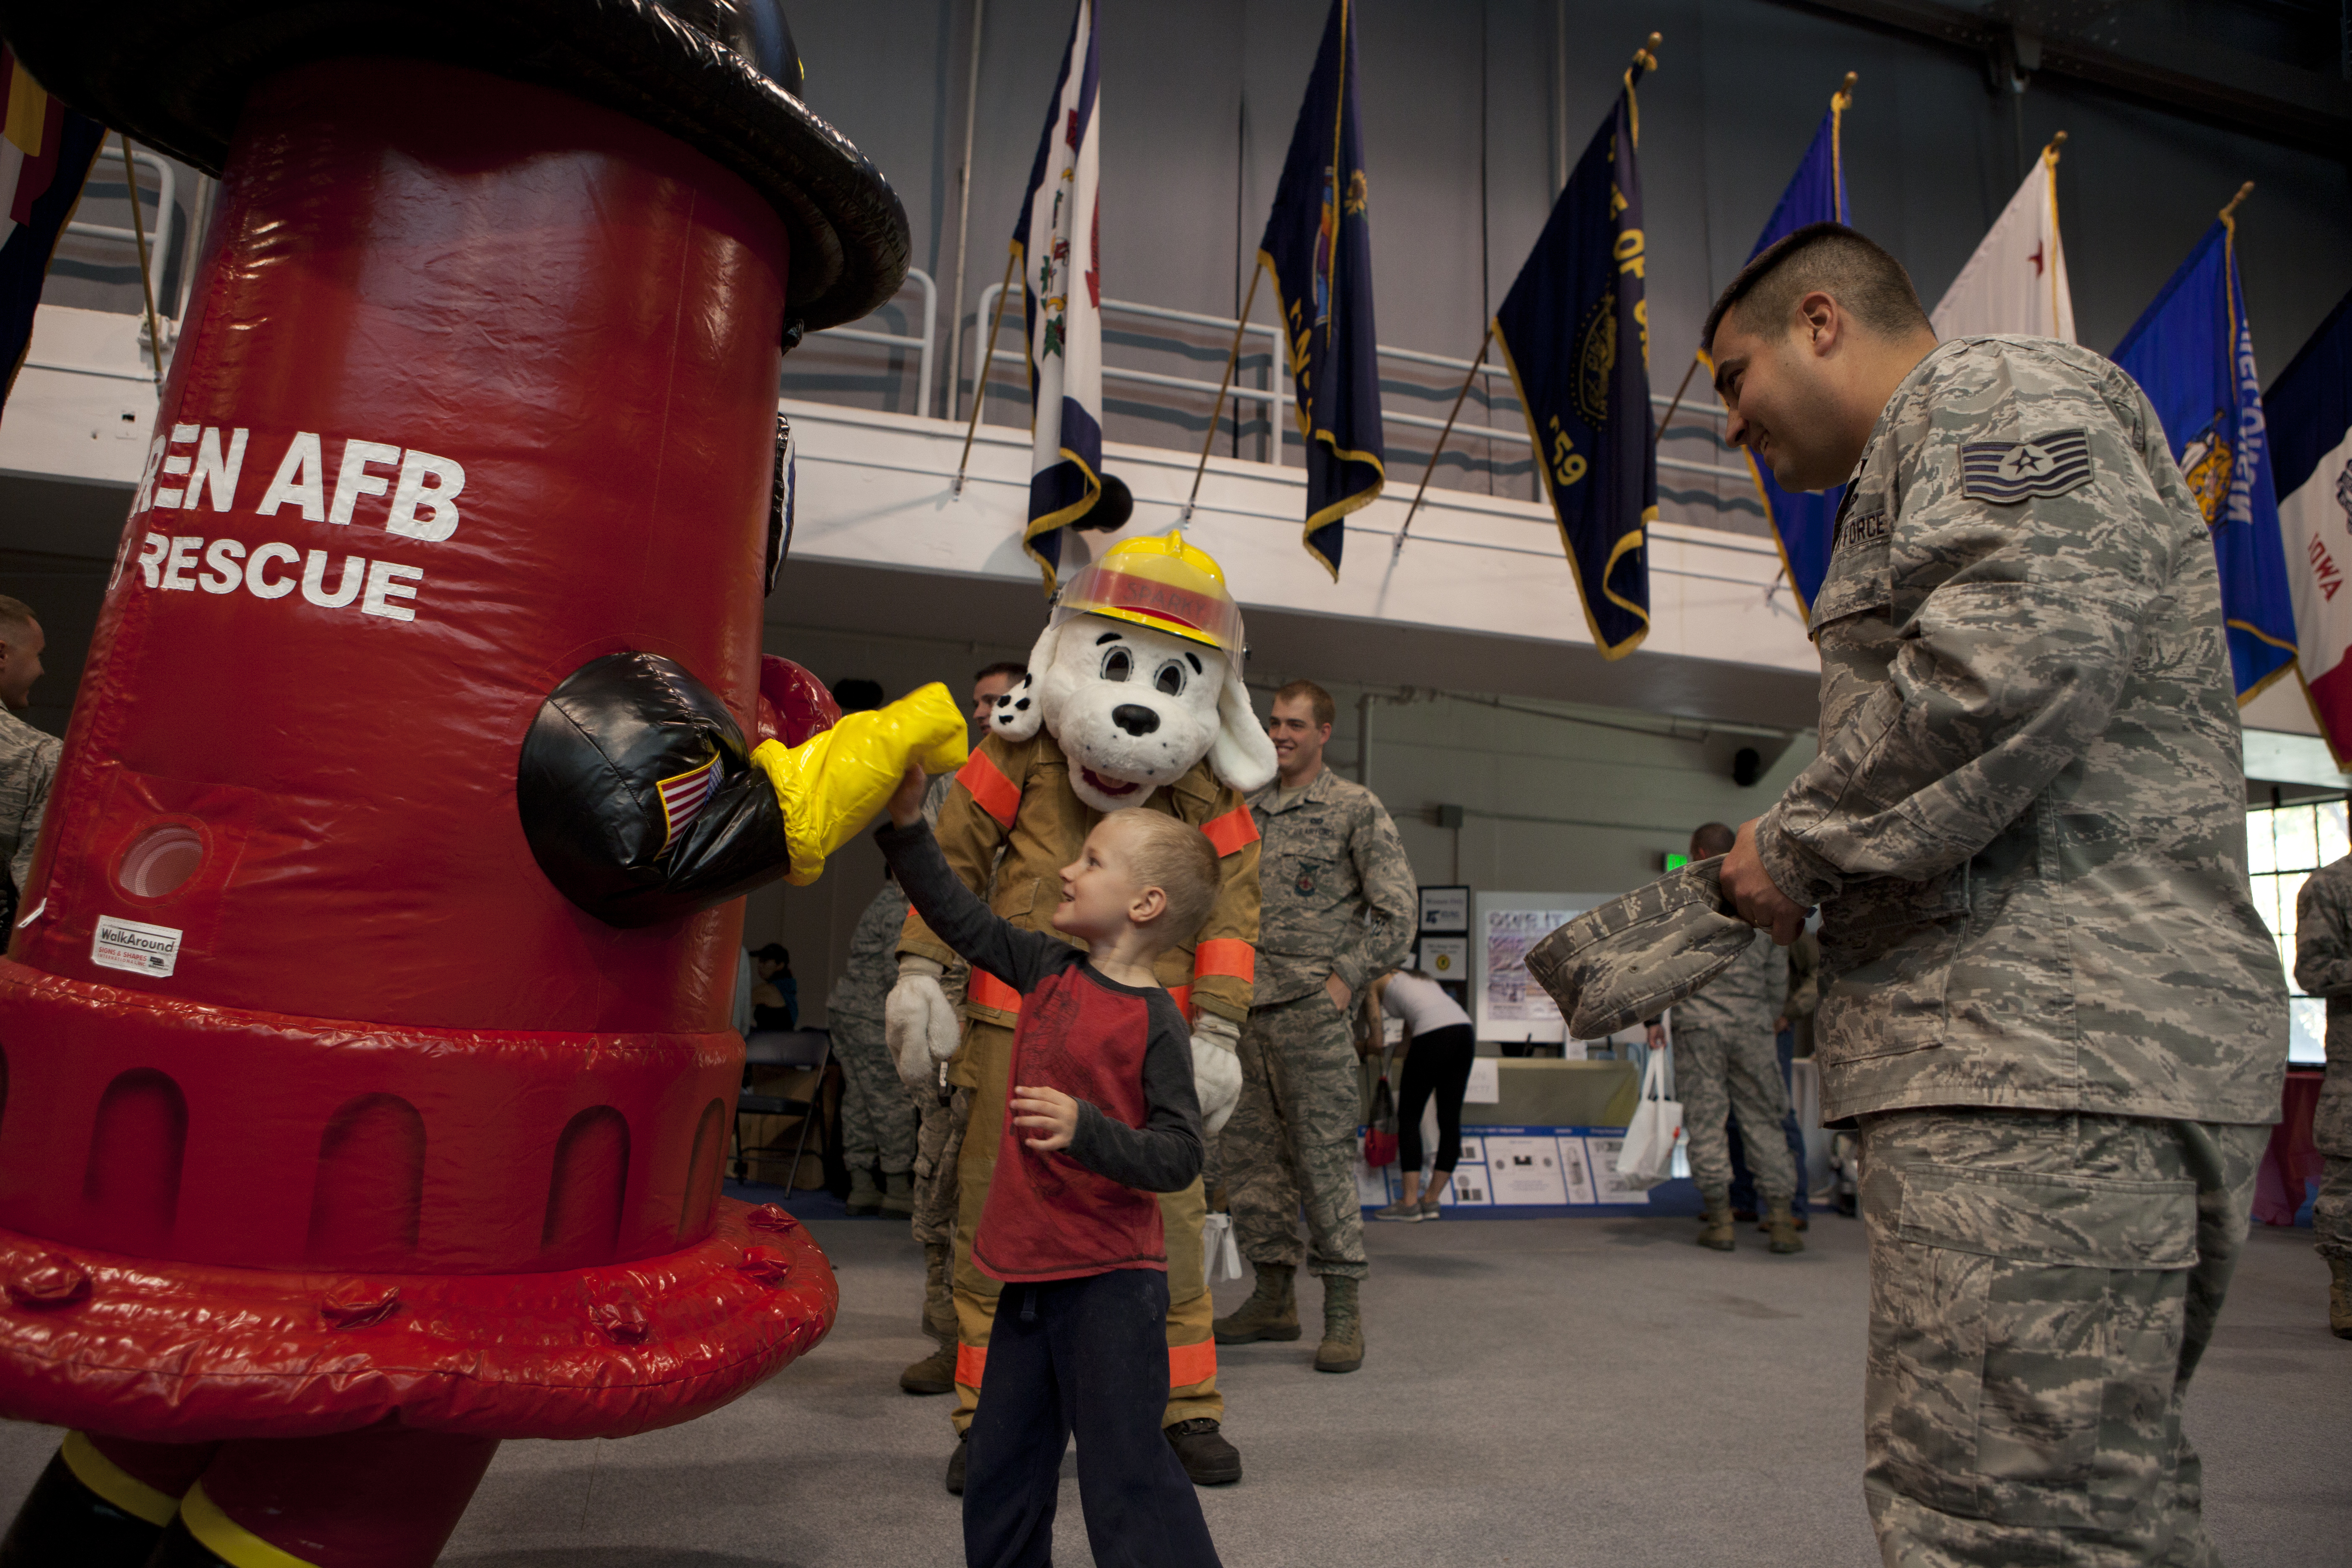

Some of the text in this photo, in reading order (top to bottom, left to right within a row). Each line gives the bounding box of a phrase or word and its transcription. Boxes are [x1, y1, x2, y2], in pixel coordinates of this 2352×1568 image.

[256, 431, 465, 542] AFB
[1843, 510, 1885, 547] FORCE
[137, 531, 423, 622] RESCUE
[1123, 582, 1205, 618] SPARKY
[99, 946, 116, 955] SIGNS
[123, 952, 147, 962] SHAPES
[102, 928, 175, 952] WalkAround
